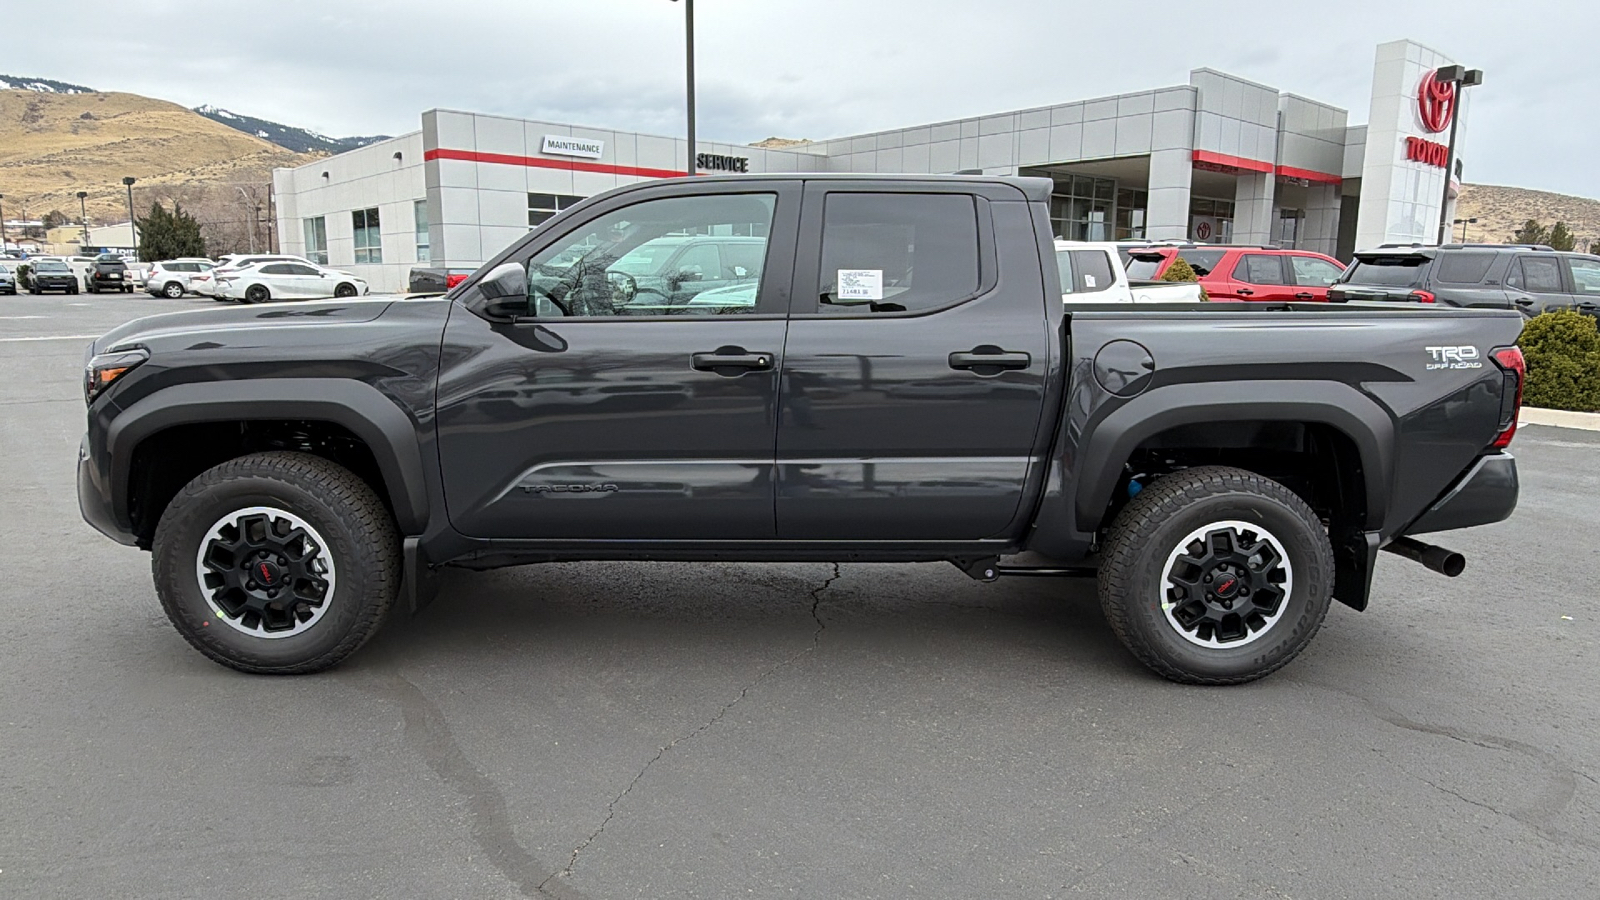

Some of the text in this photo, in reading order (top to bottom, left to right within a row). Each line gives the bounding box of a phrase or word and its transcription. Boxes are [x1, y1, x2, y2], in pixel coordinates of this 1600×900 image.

[547, 140, 600, 154] MAINTENANCE
[1406, 136, 1449, 168] TOYOT
[697, 153, 749, 172] SERVICE
[1425, 346, 1479, 362] TRD
[519, 484, 619, 493] TACOMA
